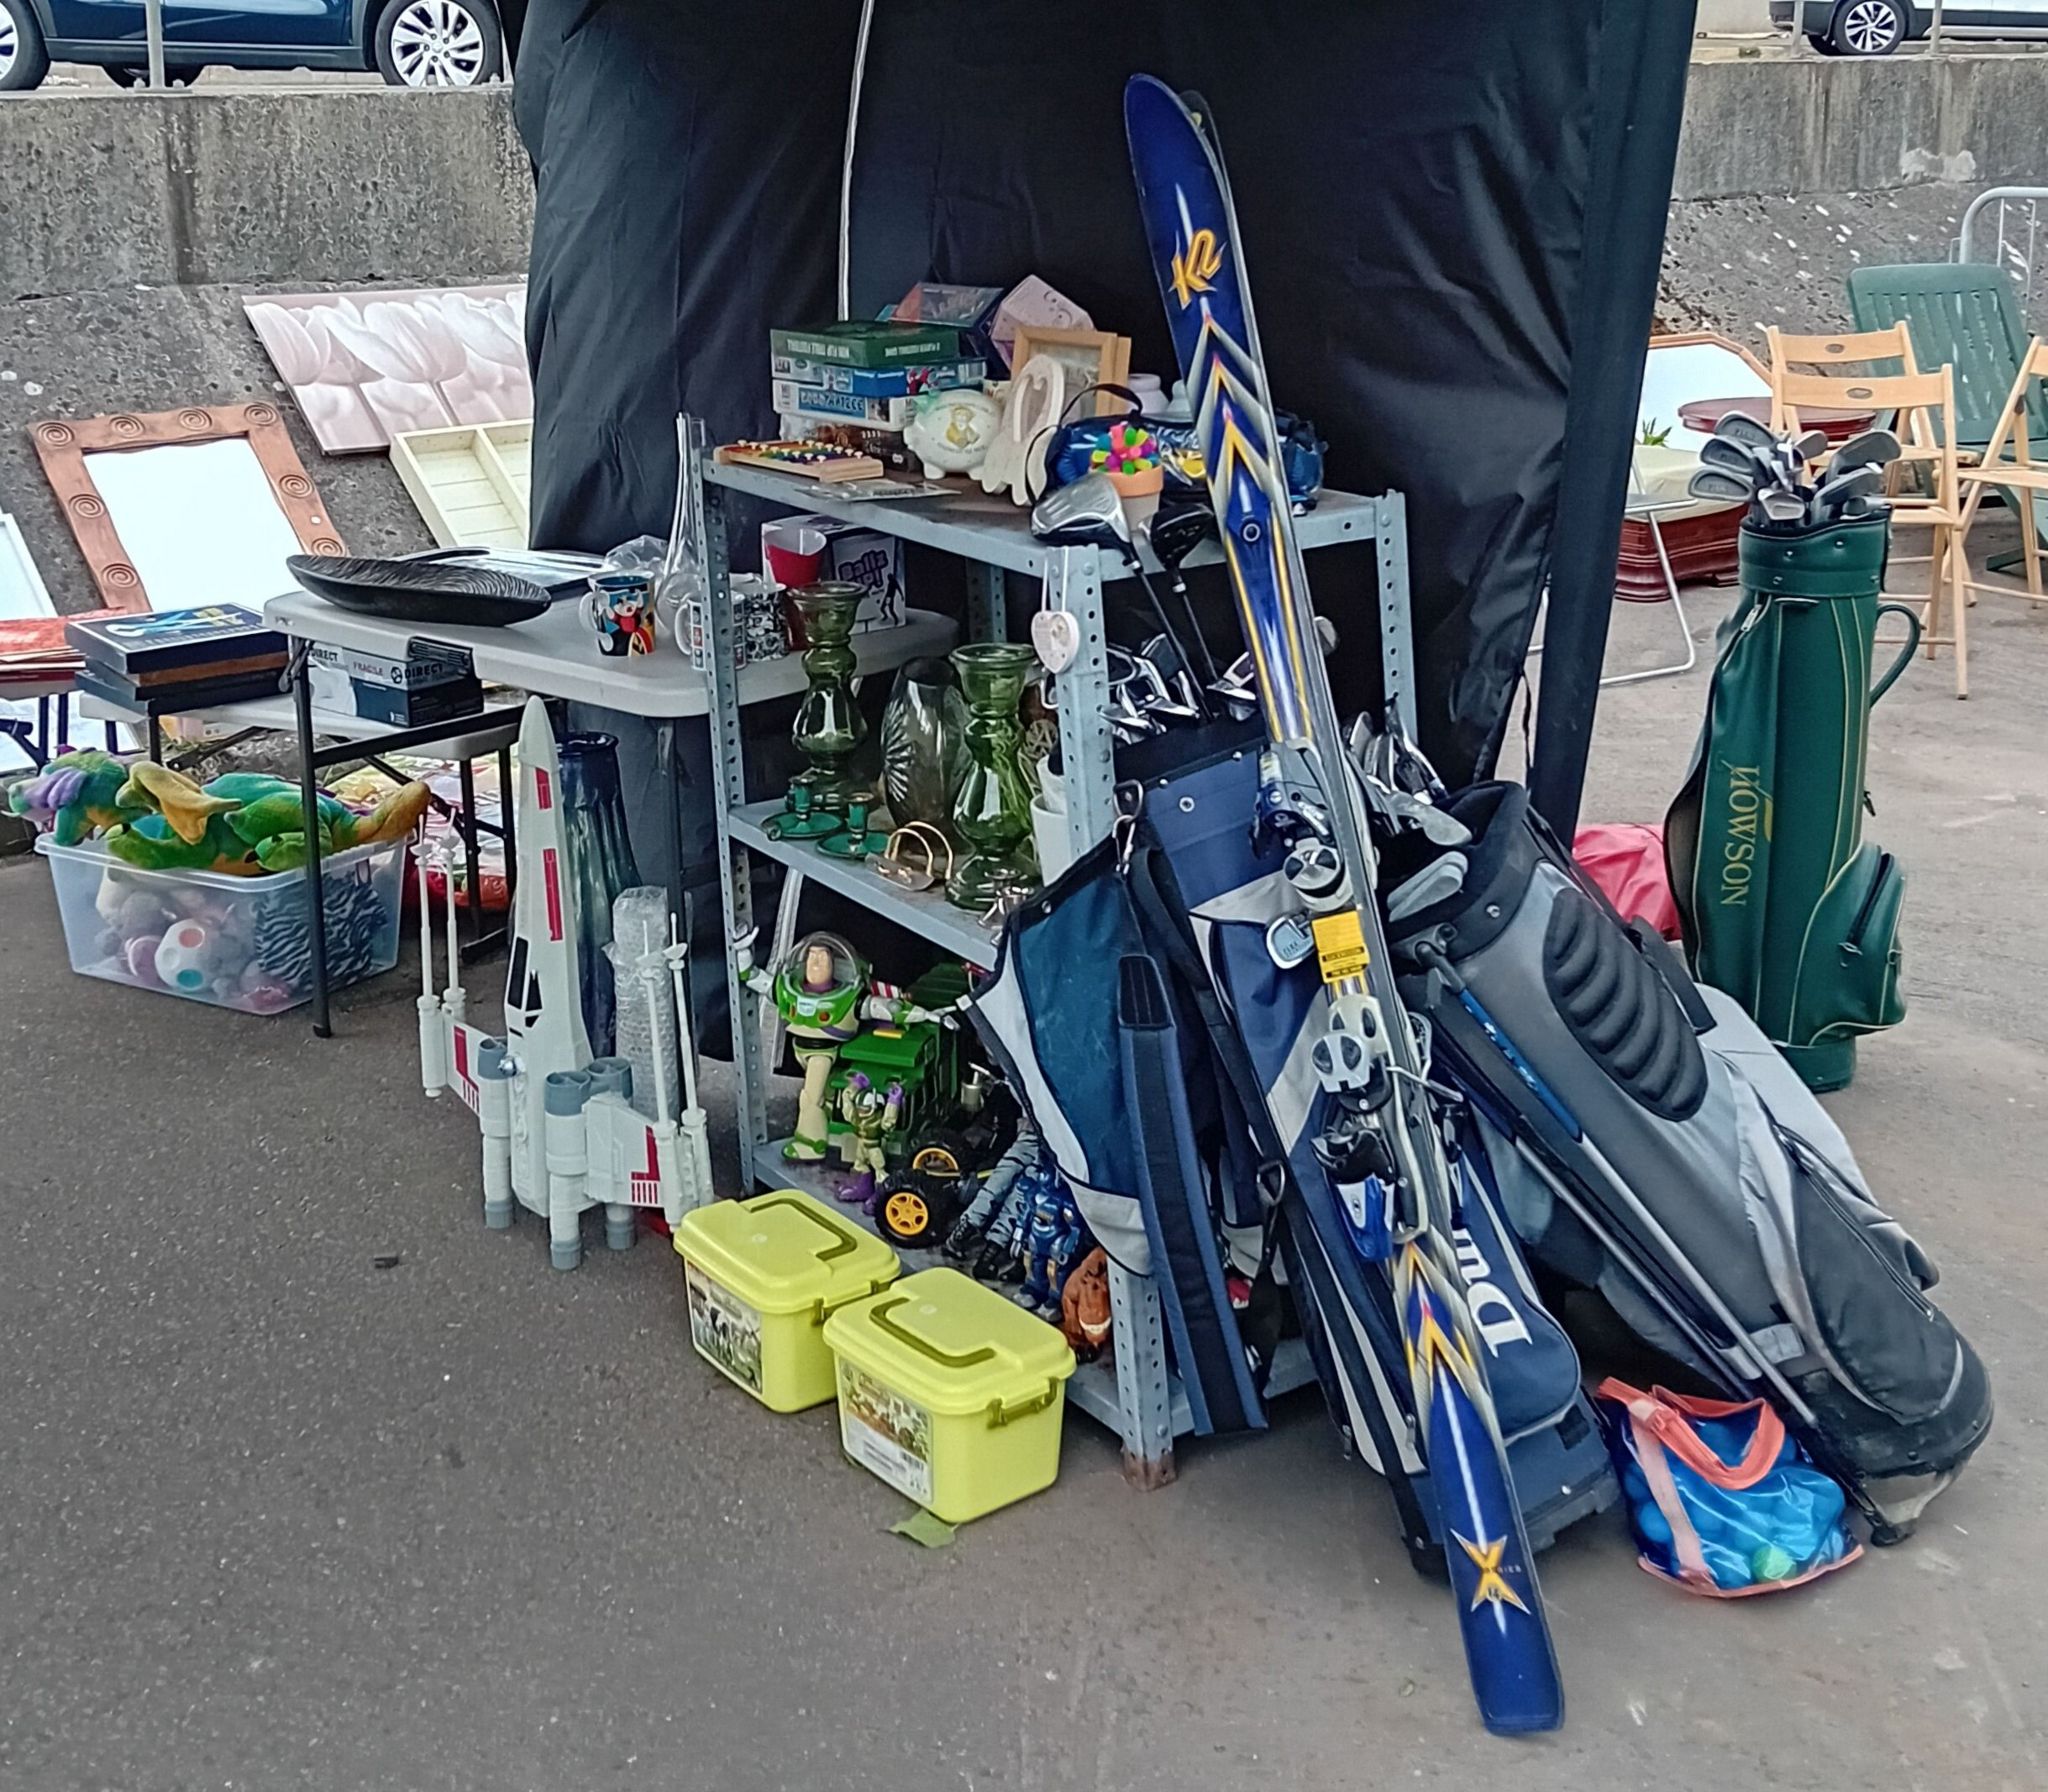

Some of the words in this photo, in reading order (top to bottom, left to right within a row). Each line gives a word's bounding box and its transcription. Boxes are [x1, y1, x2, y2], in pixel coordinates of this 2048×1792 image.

[1168, 229, 1226, 310] K2
[353, 661, 384, 677] FRAGILE
[405, 663, 443, 679] DIRECT
